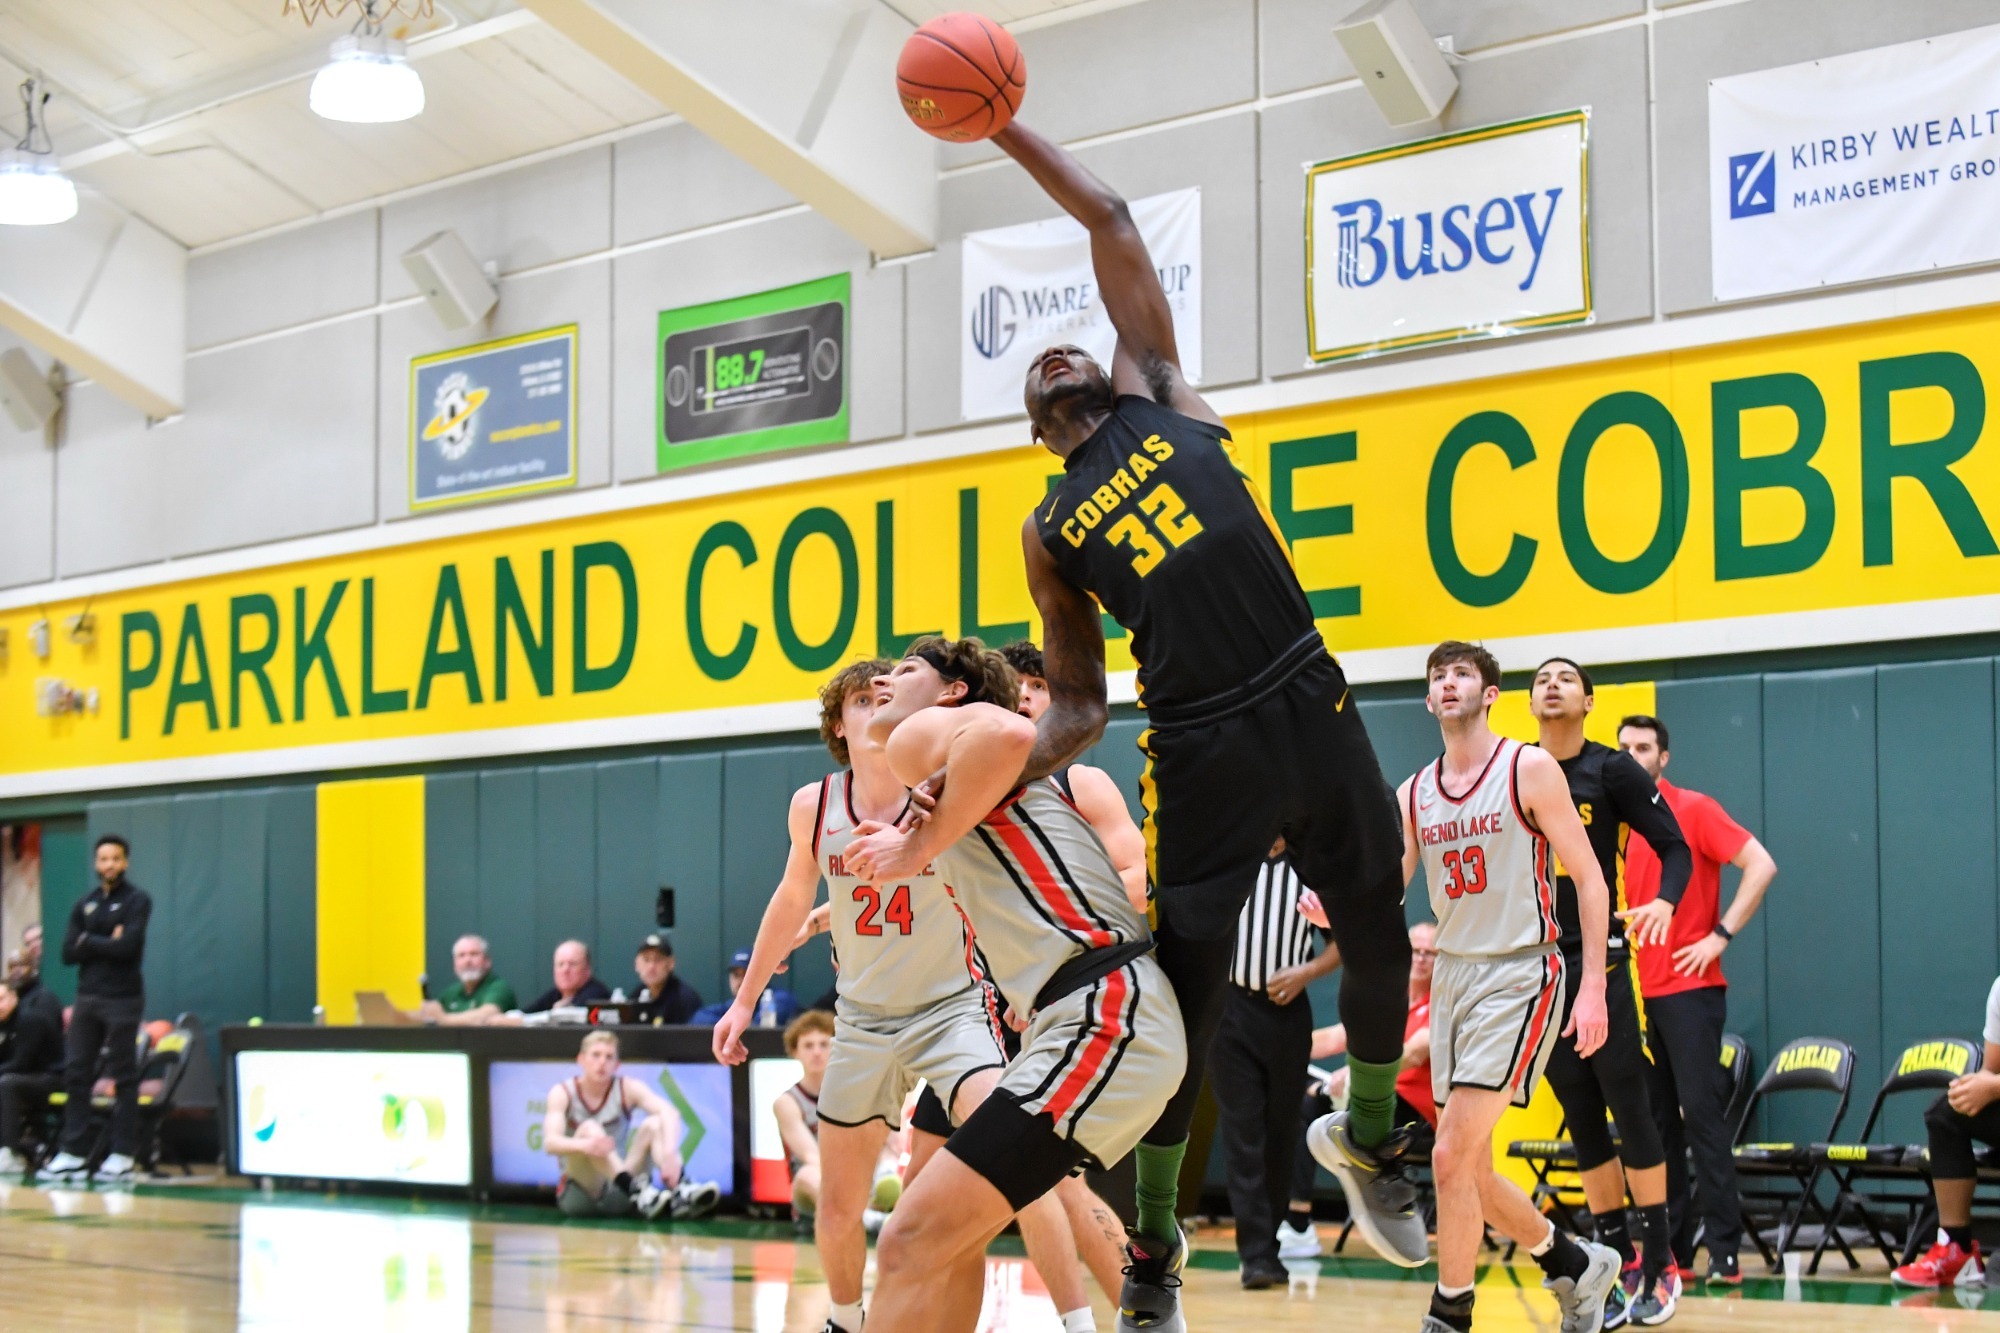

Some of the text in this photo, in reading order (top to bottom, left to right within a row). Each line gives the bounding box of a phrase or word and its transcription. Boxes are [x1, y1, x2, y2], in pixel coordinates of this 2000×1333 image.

[1791, 131, 1877, 170] KIRBY
[1793, 157, 2000, 208] MANAGEMENT GRO
[1332, 188, 1564, 292] Busey
[1022, 283, 1092, 319] WARE
[715, 349, 766, 390] 88.7
[1060, 434, 1174, 548] COBRAS
[1104, 482, 1204, 579] 32
[119, 541, 639, 741] PARKLAND
[685, 431, 1361, 682] COLLE
[1421, 812, 1503, 847] REND LAKE
[1442, 845, 1488, 900] 33
[852, 885, 914, 937] 24
[1776, 1044, 1843, 1075] PARKLAND
[1897, 1041, 1970, 1077] PARKLAND
